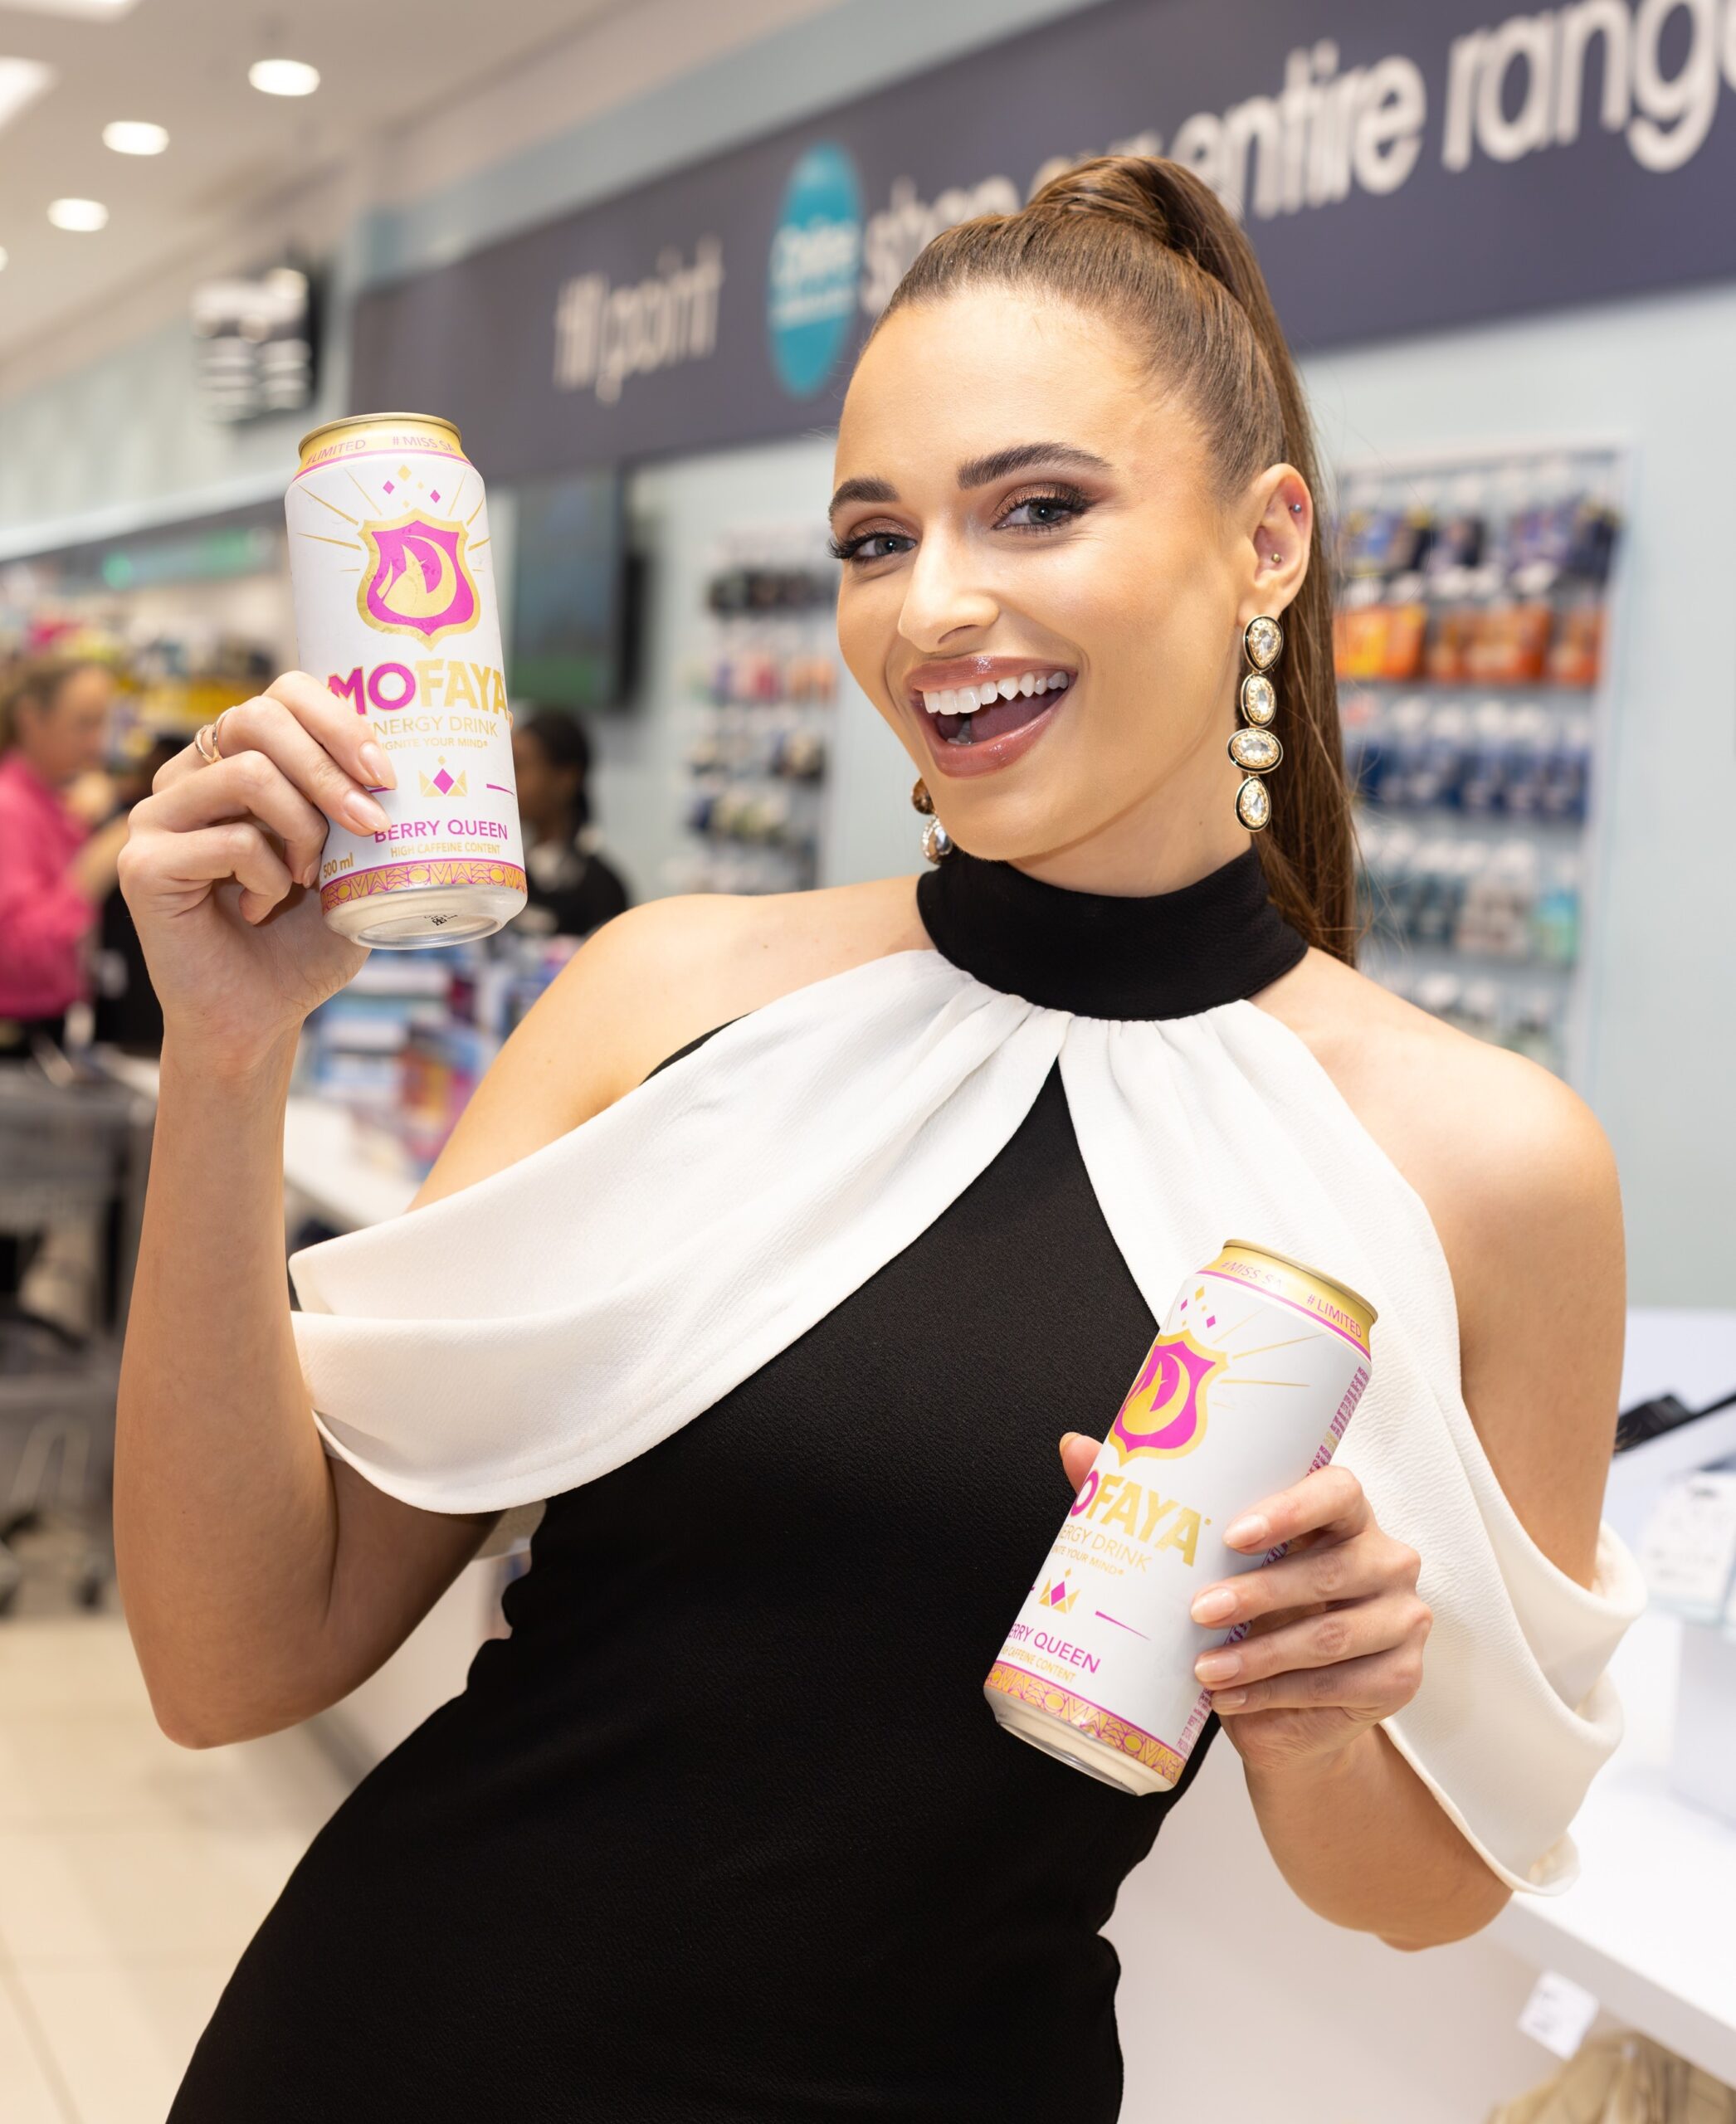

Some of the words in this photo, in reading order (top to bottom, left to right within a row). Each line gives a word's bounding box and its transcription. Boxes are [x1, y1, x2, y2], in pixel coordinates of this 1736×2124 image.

[1441, 0, 1736, 173] rang
[369, 716, 443, 736] NERGY
[449, 716, 499, 738] DRINK
[424, 737, 456, 748] YOUR
[374, 819, 441, 844] BERRY
[447, 819, 509, 840] QUEEN
[390, 845, 415, 858] HIGH
[417, 842, 463, 855] CAFFEINE
[465, 841, 501, 855] CONTENT
[322, 858, 339, 879] 500
[339, 852, 354, 870] ml
[1070, 1469, 1202, 1567] OFAYA
[1090, 1533, 1153, 1572] DRINK
[1033, 1631, 1101, 1673] QUEEN
[1036, 1657, 1076, 1683] CONTENT
